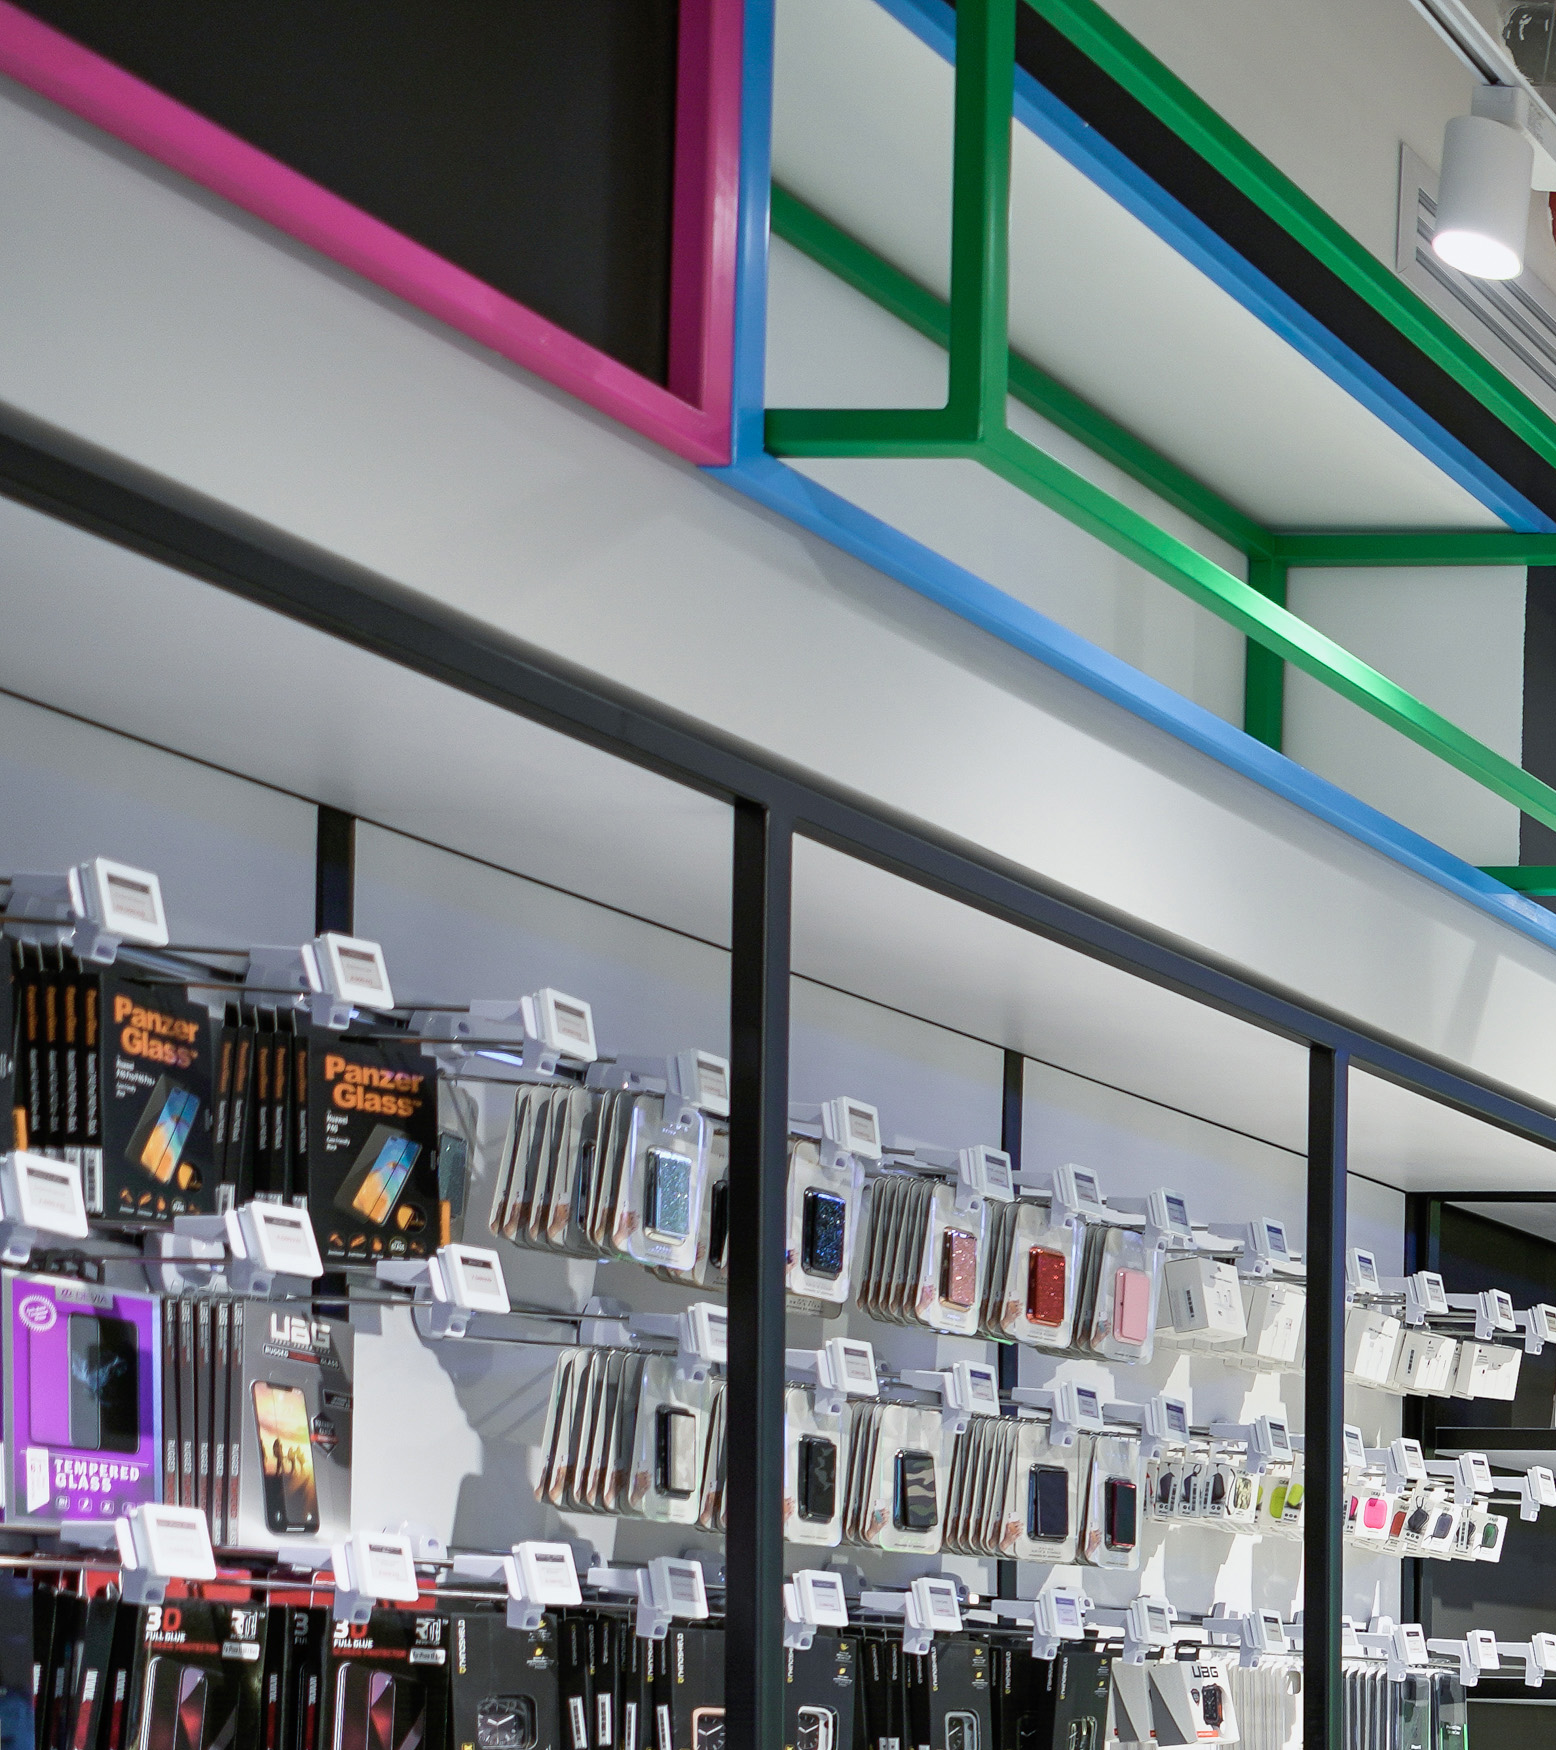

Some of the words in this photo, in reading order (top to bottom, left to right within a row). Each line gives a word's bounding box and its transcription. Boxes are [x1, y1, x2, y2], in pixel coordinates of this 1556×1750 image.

[113, 994, 200, 1044] Panzer
[120, 1023, 192, 1069] Glass
[324, 1053, 425, 1095] Panzer
[332, 1083, 413, 1118] Glass
[270, 1311, 332, 1350] UAG
[264, 1345, 289, 1360] RUGGED
[319, 1356, 340, 1370] GLASS
[54, 1458, 140, 1483] TEMPERED
[54, 1474, 113, 1493] GLASS
[145, 1605, 182, 1633] 3D
[144, 1631, 164, 1643] FULL
[164, 1631, 187, 1644] GLUE
[333, 1638, 353, 1649] FULL
[353, 1638, 374, 1650] GLUE
[1191, 1665, 1219, 1679] UAG
